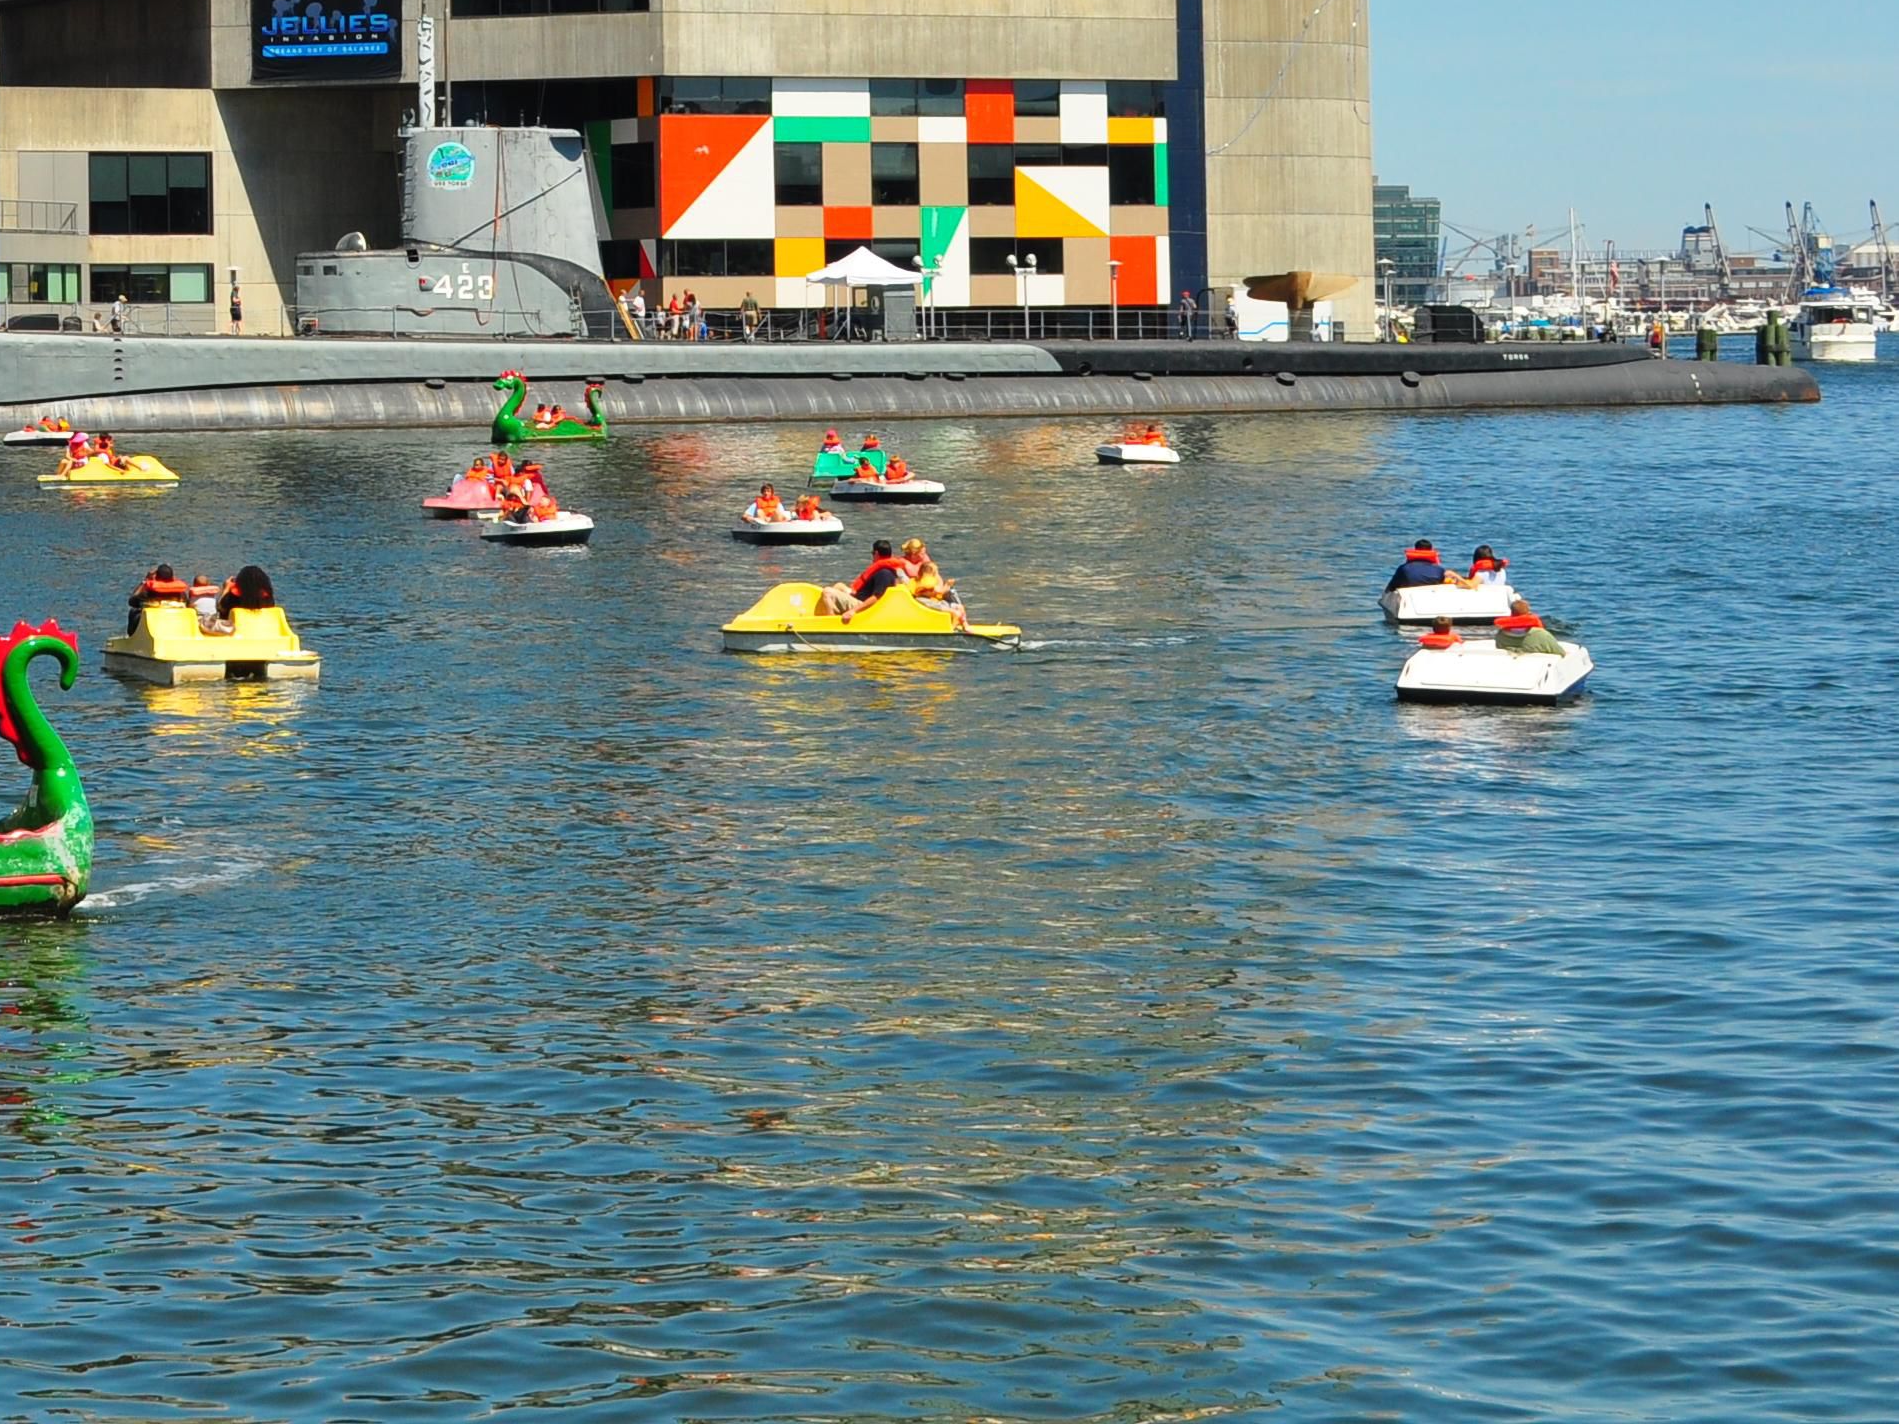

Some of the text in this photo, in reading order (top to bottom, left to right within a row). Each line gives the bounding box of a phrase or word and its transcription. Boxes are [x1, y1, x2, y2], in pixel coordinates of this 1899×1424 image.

[261, 13, 390, 36] JELLIES
[270, 33, 379, 43] INVASION
[462, 262, 470, 274] E
[432, 274, 494, 300] 423
